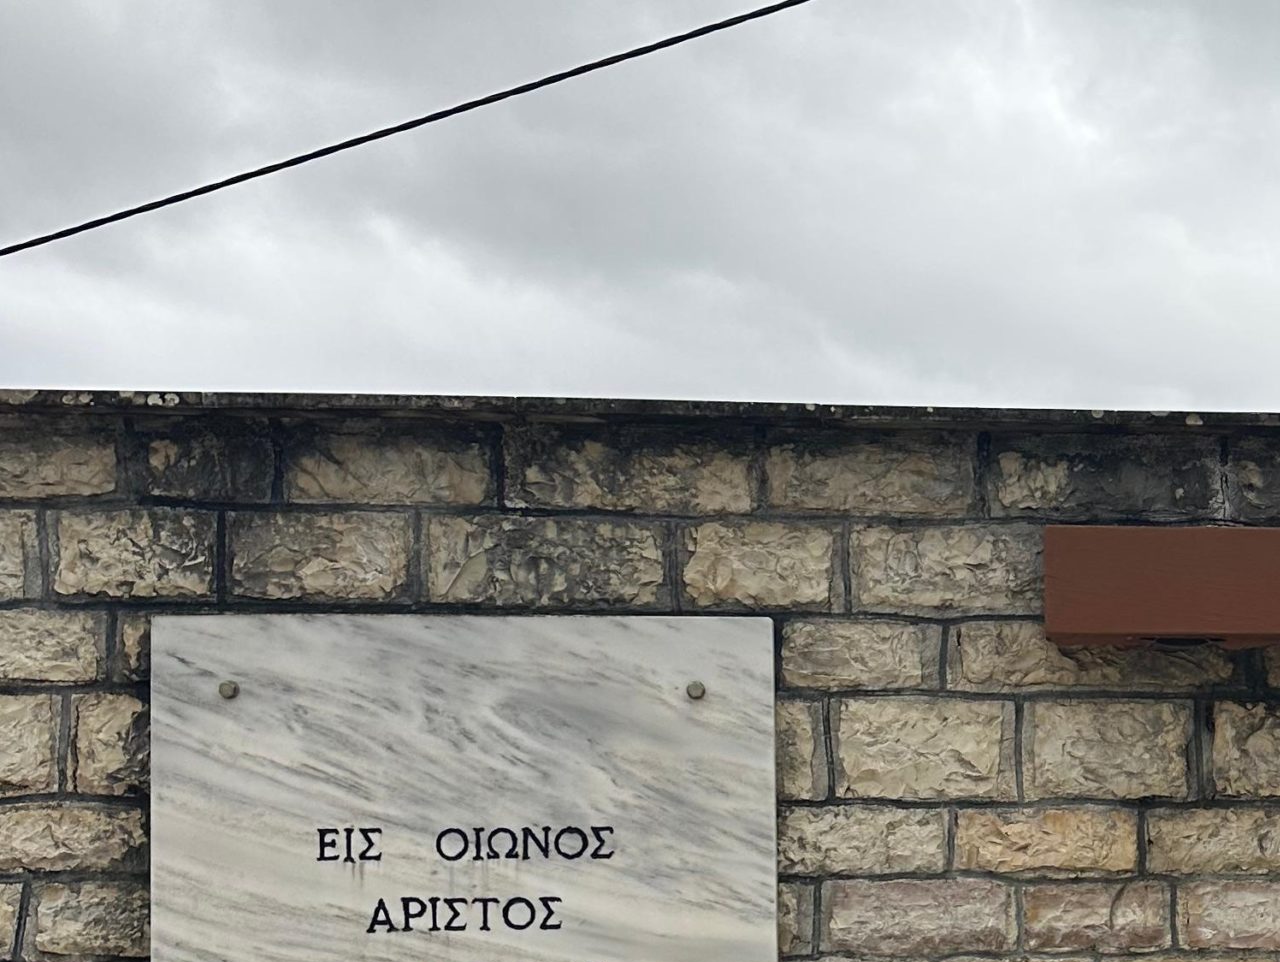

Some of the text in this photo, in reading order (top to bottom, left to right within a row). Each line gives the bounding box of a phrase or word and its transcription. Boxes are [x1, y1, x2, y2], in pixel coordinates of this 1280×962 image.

[316, 826, 615, 862] ΕΙΣ ΟΙΩΝΟΣ
[365, 896, 563, 934] ΑΡΙΣΤΟΣ
